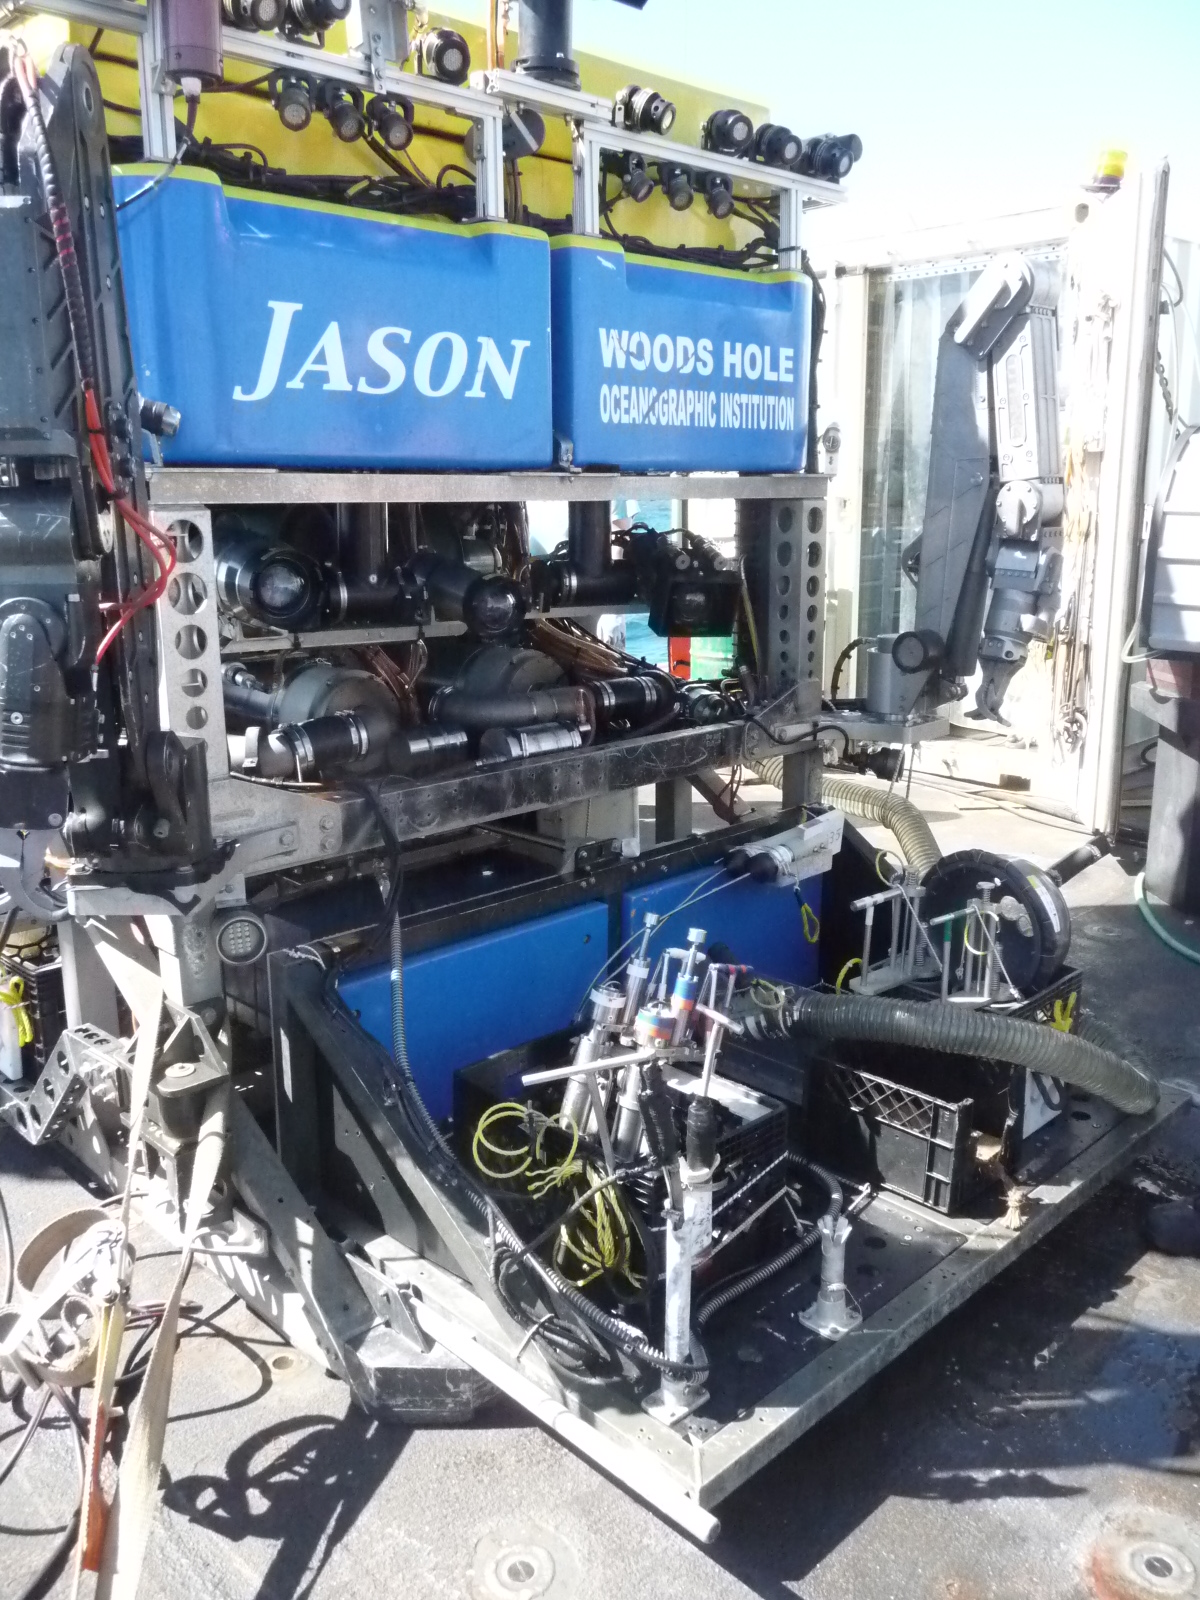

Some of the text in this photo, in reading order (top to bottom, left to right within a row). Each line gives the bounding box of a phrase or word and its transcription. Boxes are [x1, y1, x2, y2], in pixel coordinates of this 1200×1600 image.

[232, 300, 531, 401] JASON
[598, 327, 794, 382] WOODS HOLE
[600, 384, 794, 431] OCEANOGRAPHIC INSTITUTION
